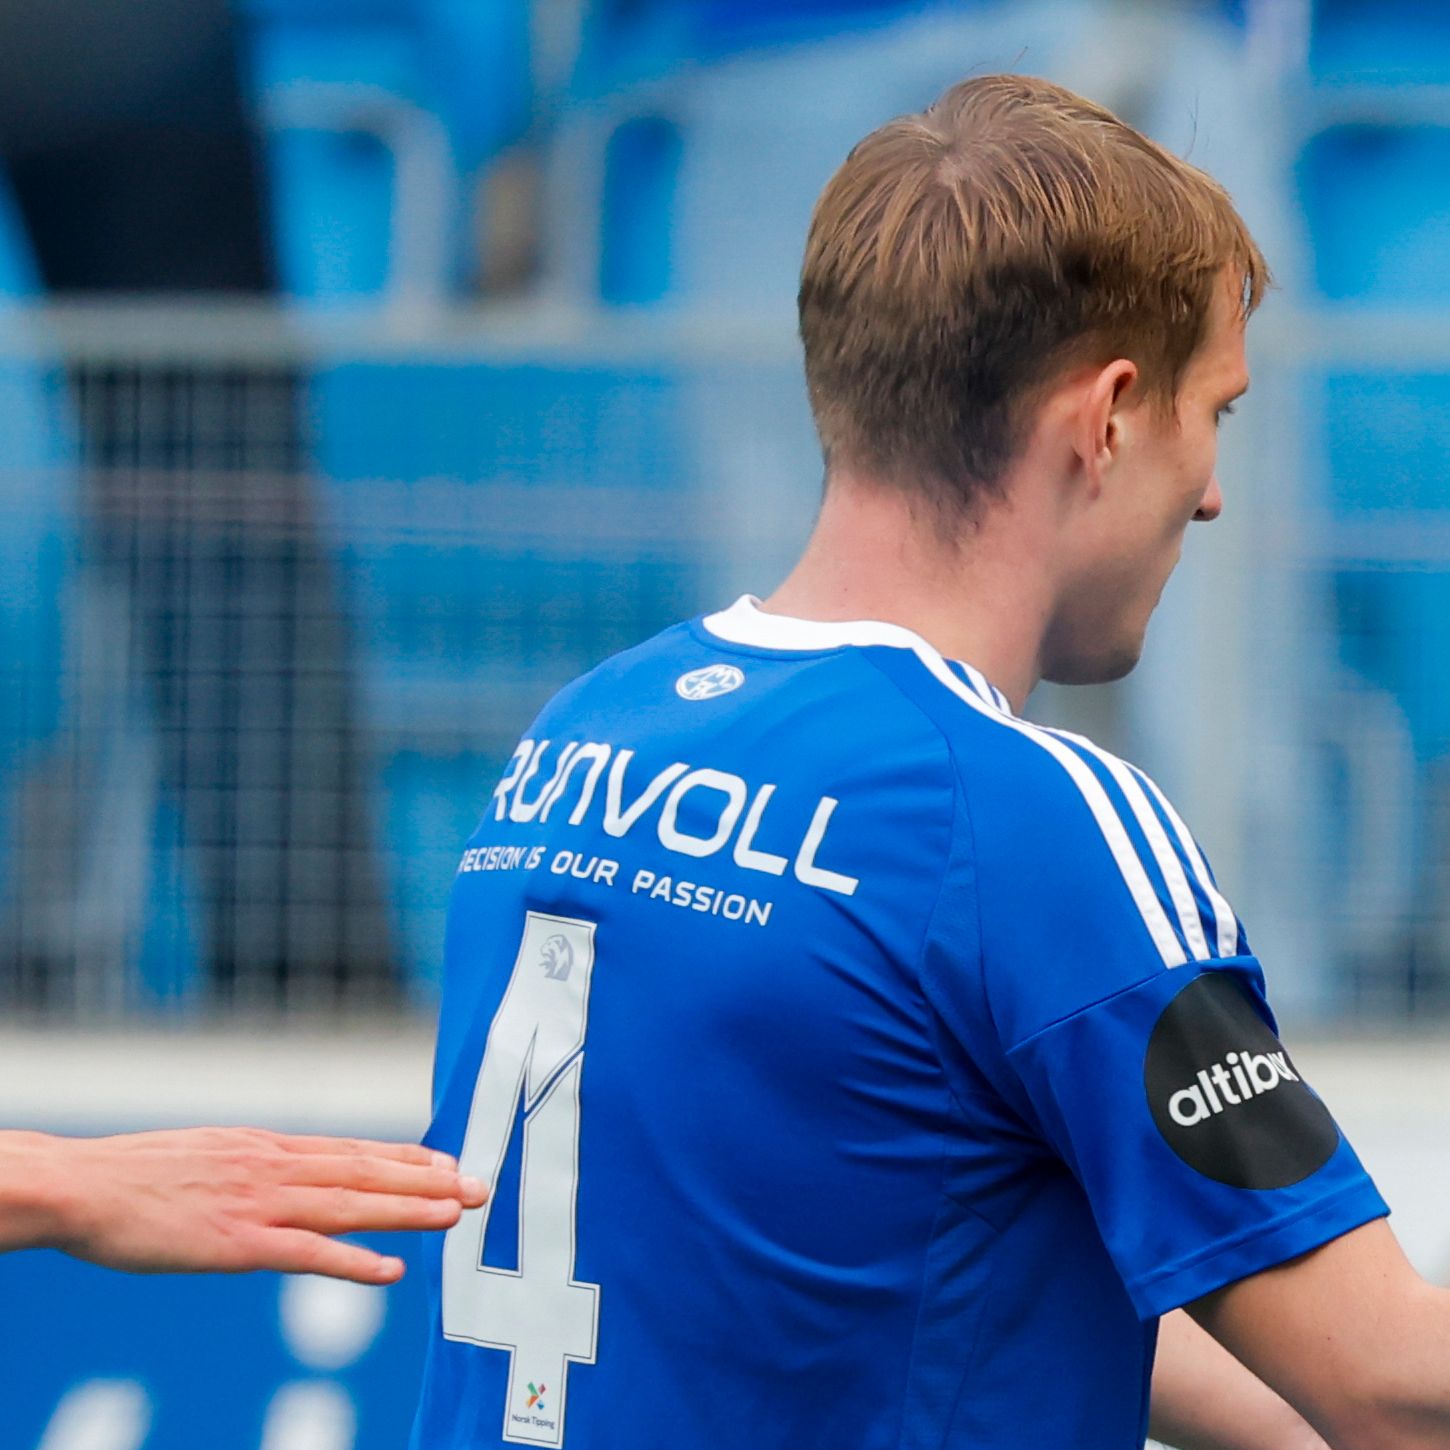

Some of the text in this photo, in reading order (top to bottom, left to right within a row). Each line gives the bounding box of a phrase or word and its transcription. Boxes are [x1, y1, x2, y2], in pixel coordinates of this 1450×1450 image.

[524, 846, 547, 870] IS
[551, 850, 619, 886] OUR
[632, 870, 773, 926] PASSION
[442, 910, 600, 1450] 4
[512, 1414, 531, 1425] Norsk
